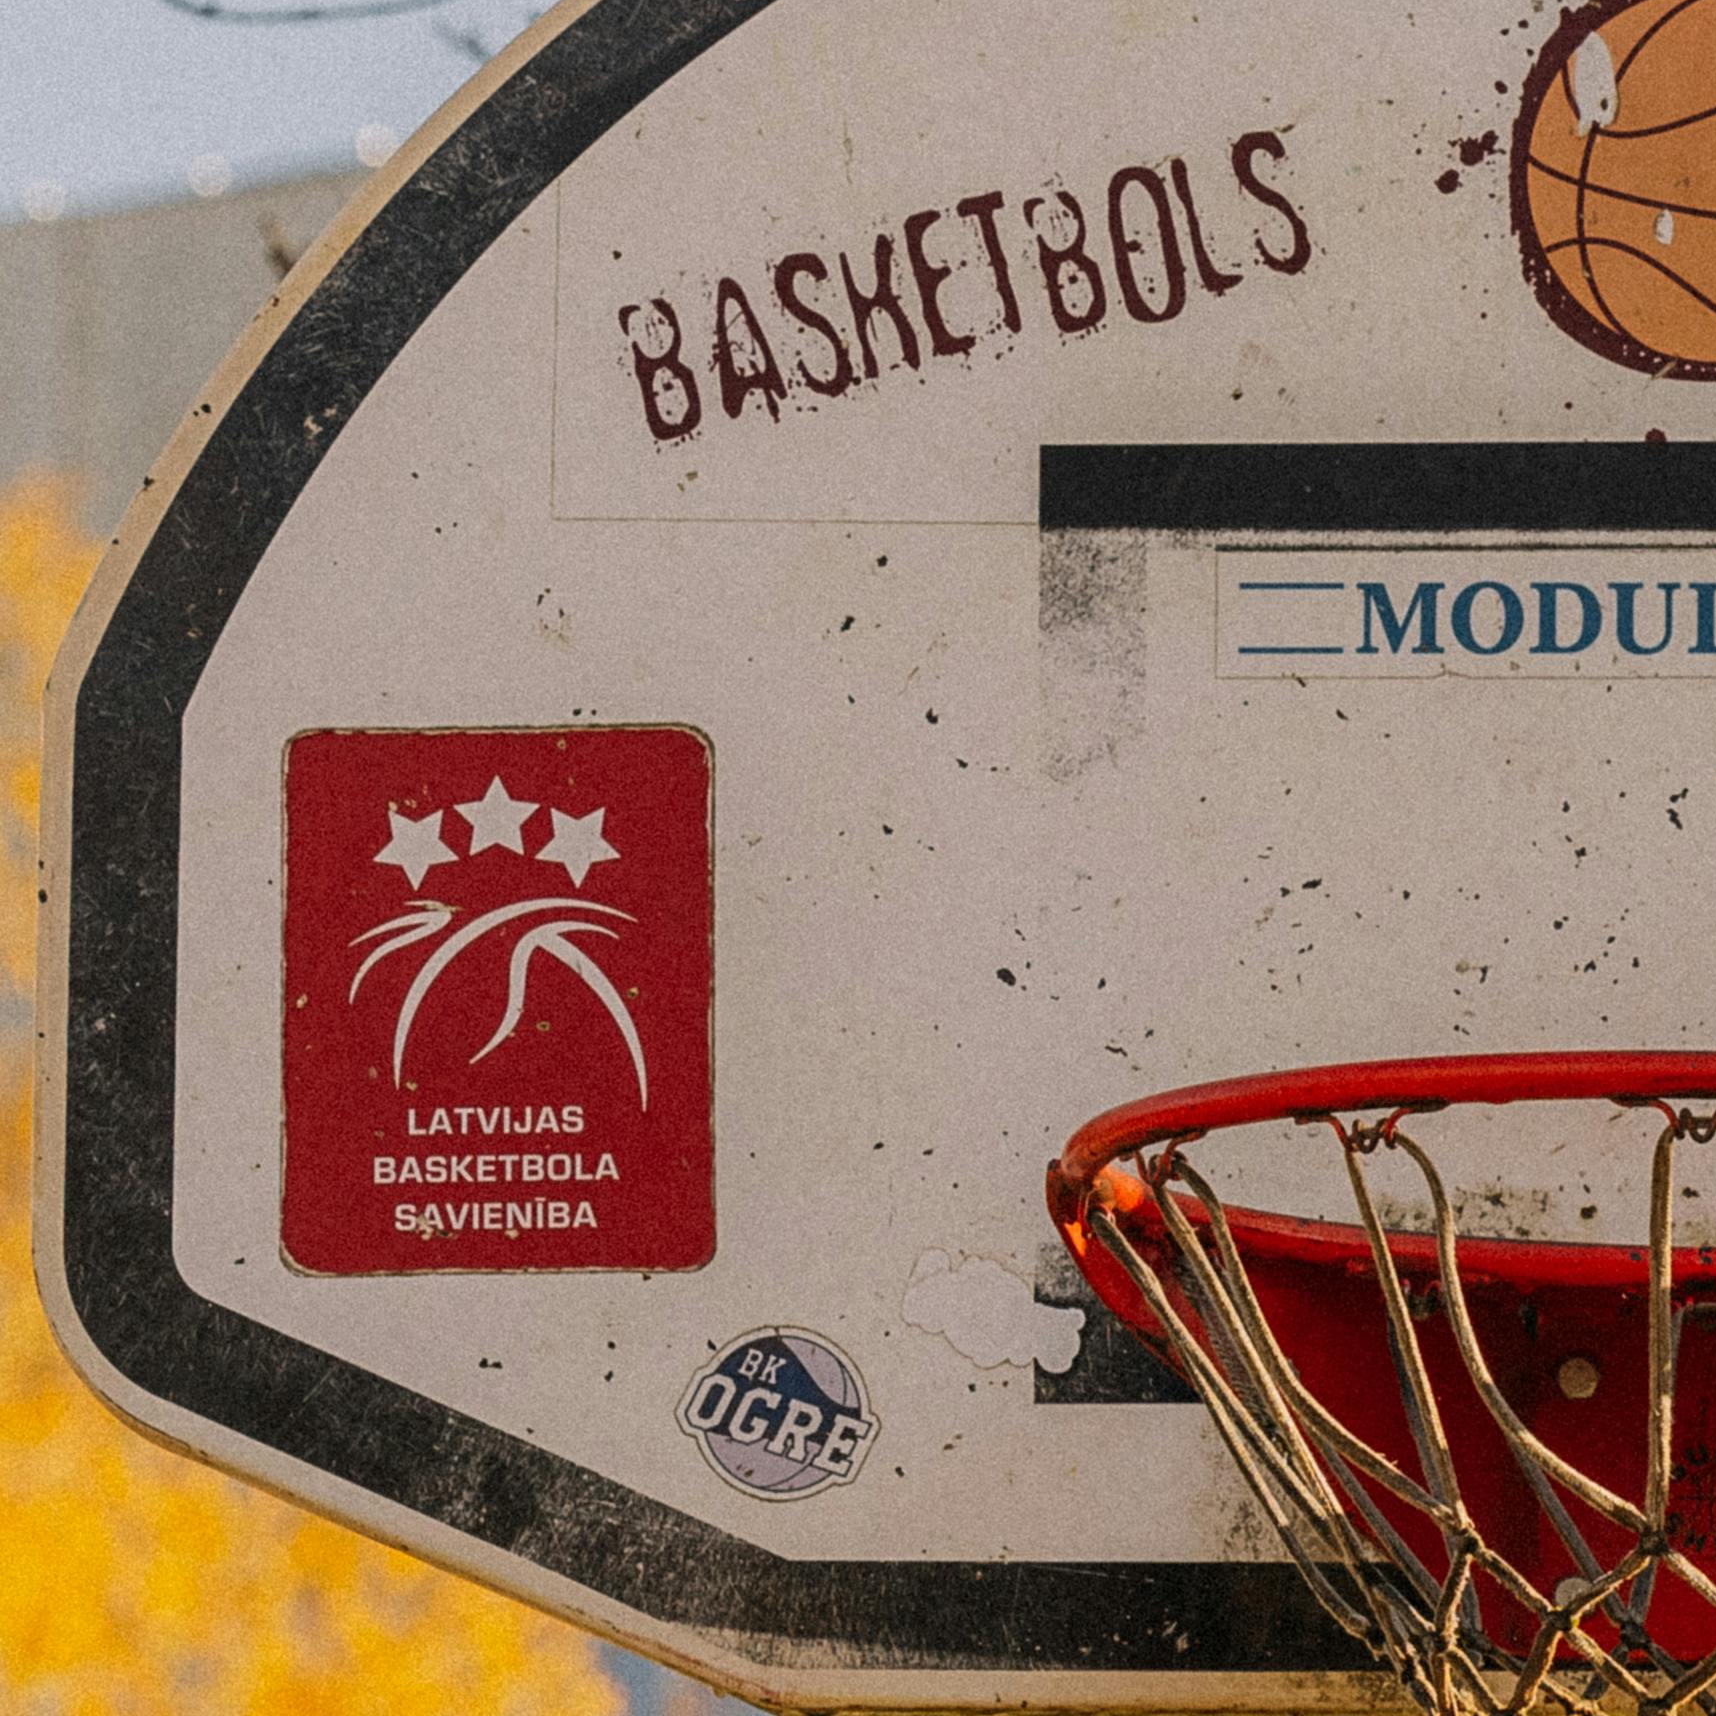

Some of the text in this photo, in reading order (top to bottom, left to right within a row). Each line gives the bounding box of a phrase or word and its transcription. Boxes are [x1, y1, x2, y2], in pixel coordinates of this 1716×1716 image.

[619, 130, 1313, 442] BASKETBOLS
[407, 1105, 585, 1136] LATVIJAS
[372, 1152, 620, 1185] BASKETBOLA
[394, 1196, 598, 1231] SAVIENĪBA
[737, 1347, 788, 1385] BK
[684, 1372, 873, 1477] OGRE
